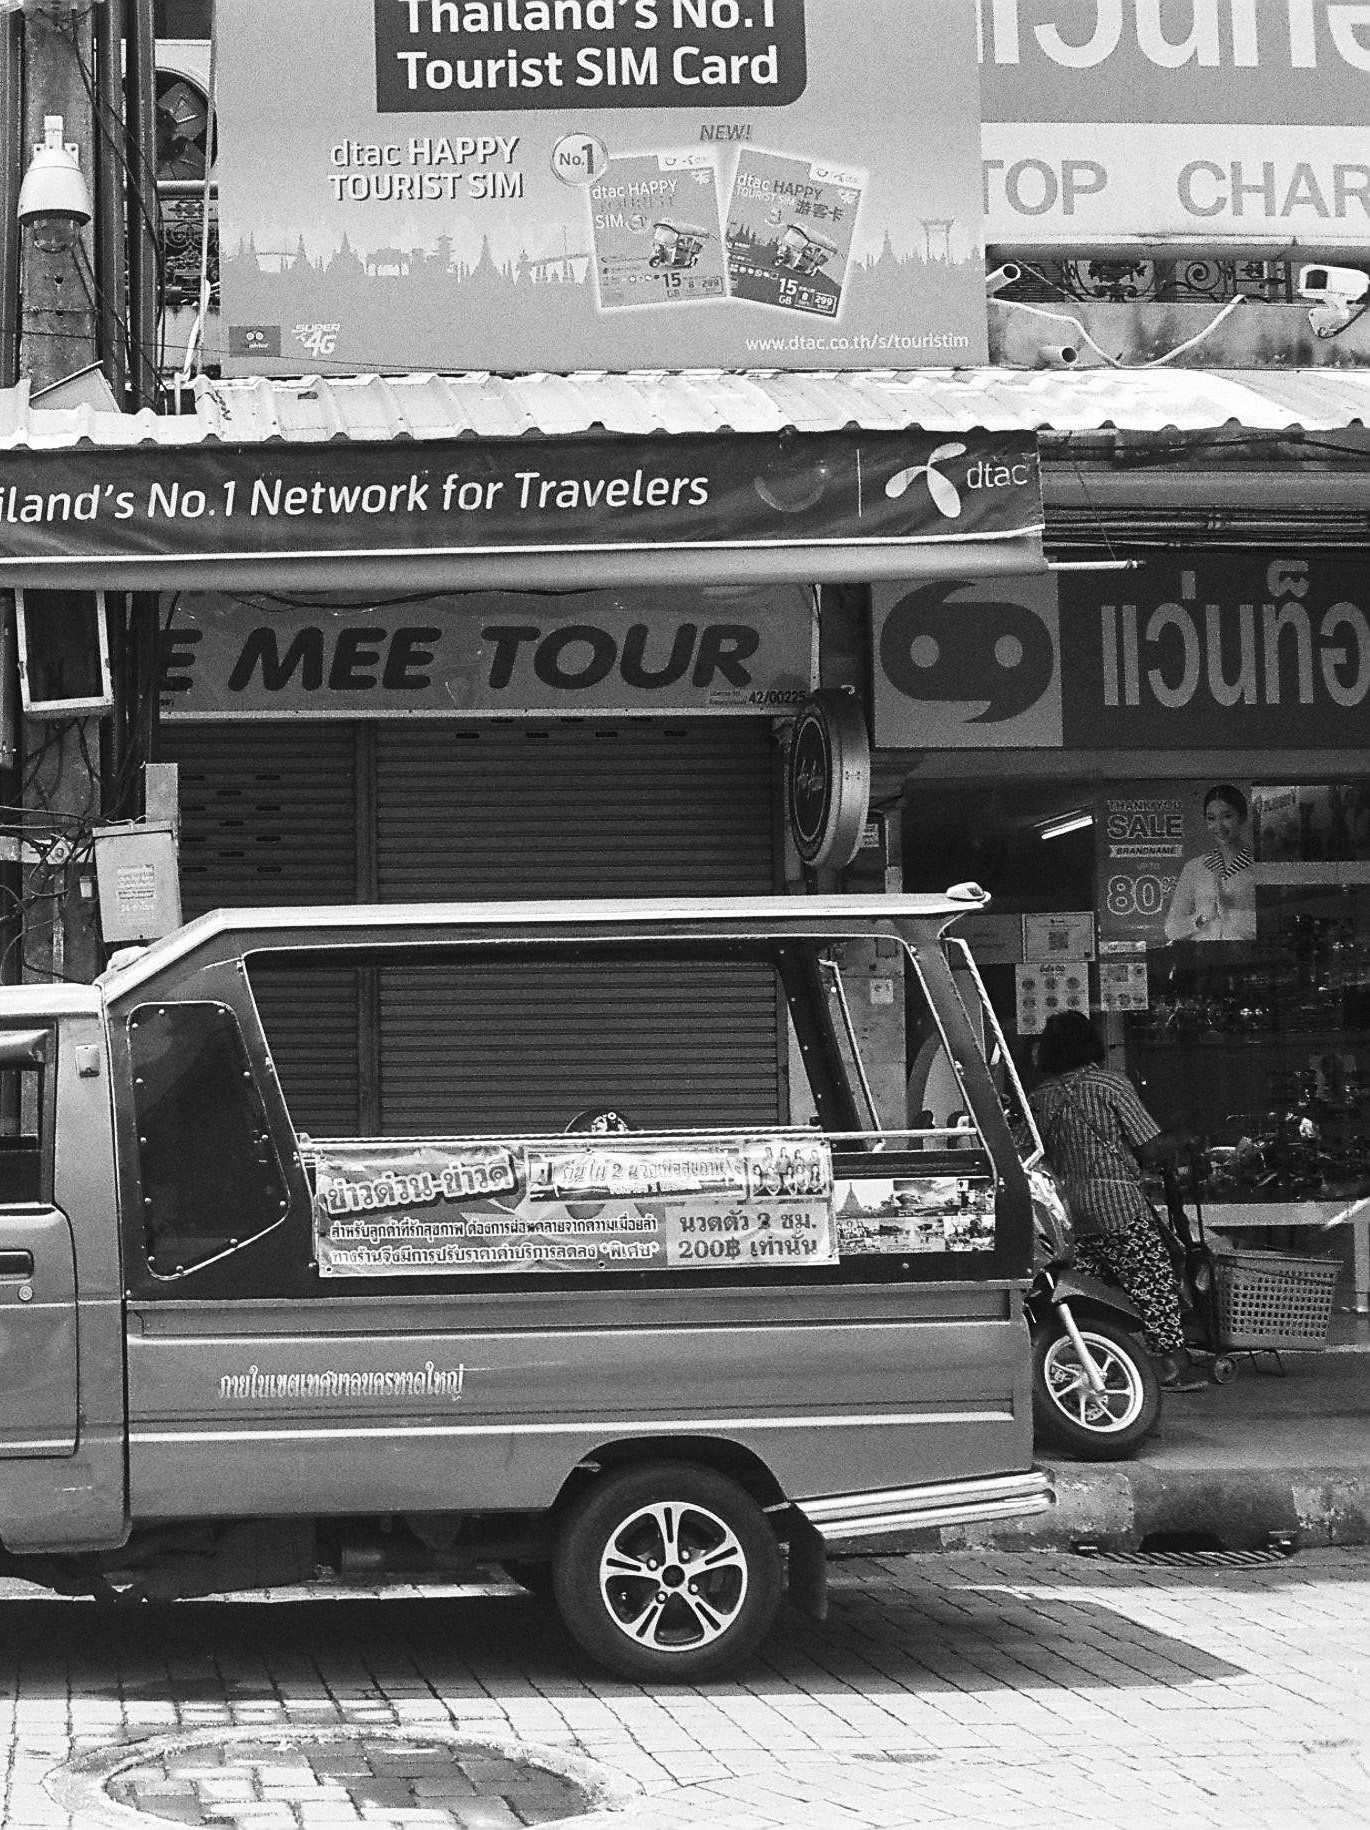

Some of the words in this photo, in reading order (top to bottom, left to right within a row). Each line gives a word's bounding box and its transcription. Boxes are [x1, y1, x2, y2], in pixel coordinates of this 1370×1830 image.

[398, 0, 658, 33] Thailand's
[673, 0, 775, 28] No.1
[397, 50, 563, 90] Tourist
[576, 46, 658, 86] SIM
[673, 45, 779, 85] Card
[700, 123, 752, 142] NEW!
[330, 139, 401, 167] dtac
[408, 136, 520, 165] HAPPY
[328, 172, 462, 201] TOURIST
[468, 171, 524, 199] SIM
[592, 184, 625, 200] dtac
[628, 179, 678, 197] HAPPY
[737, 173, 771, 191] dtac
[773, 180, 823, 201] HAPPY
[1177, 159, 1370, 218] CHAR
[595, 213, 624, 229] SIM
[663, 271, 681, 288] 15
[779, 277, 798, 295] 15
[778, 295, 792, 305] GB
[295, 323, 341, 333] SUPER
[303, 330, 338, 357] 4G
[745, 332, 969, 351] www.dtac.co.th/s/touristim
[966, 460, 1029, 490] dtac
[148, 480, 234, 519] No.1
[250, 473, 429, 518] Network
[442, 472, 503, 512] for
[515, 469, 709, 510] Travelers
[229, 626, 442, 692] MEE
[481, 622, 760, 690] TOUR
[1107, 814, 1183, 840] SALE
[1116, 846, 1177, 856] BRANDNAME
[679, 1209, 750, 1233] นวดตัว
[780, 1212, 817, 1230] ชม.
[749, 1230, 818, 1257] เท่านั้น
